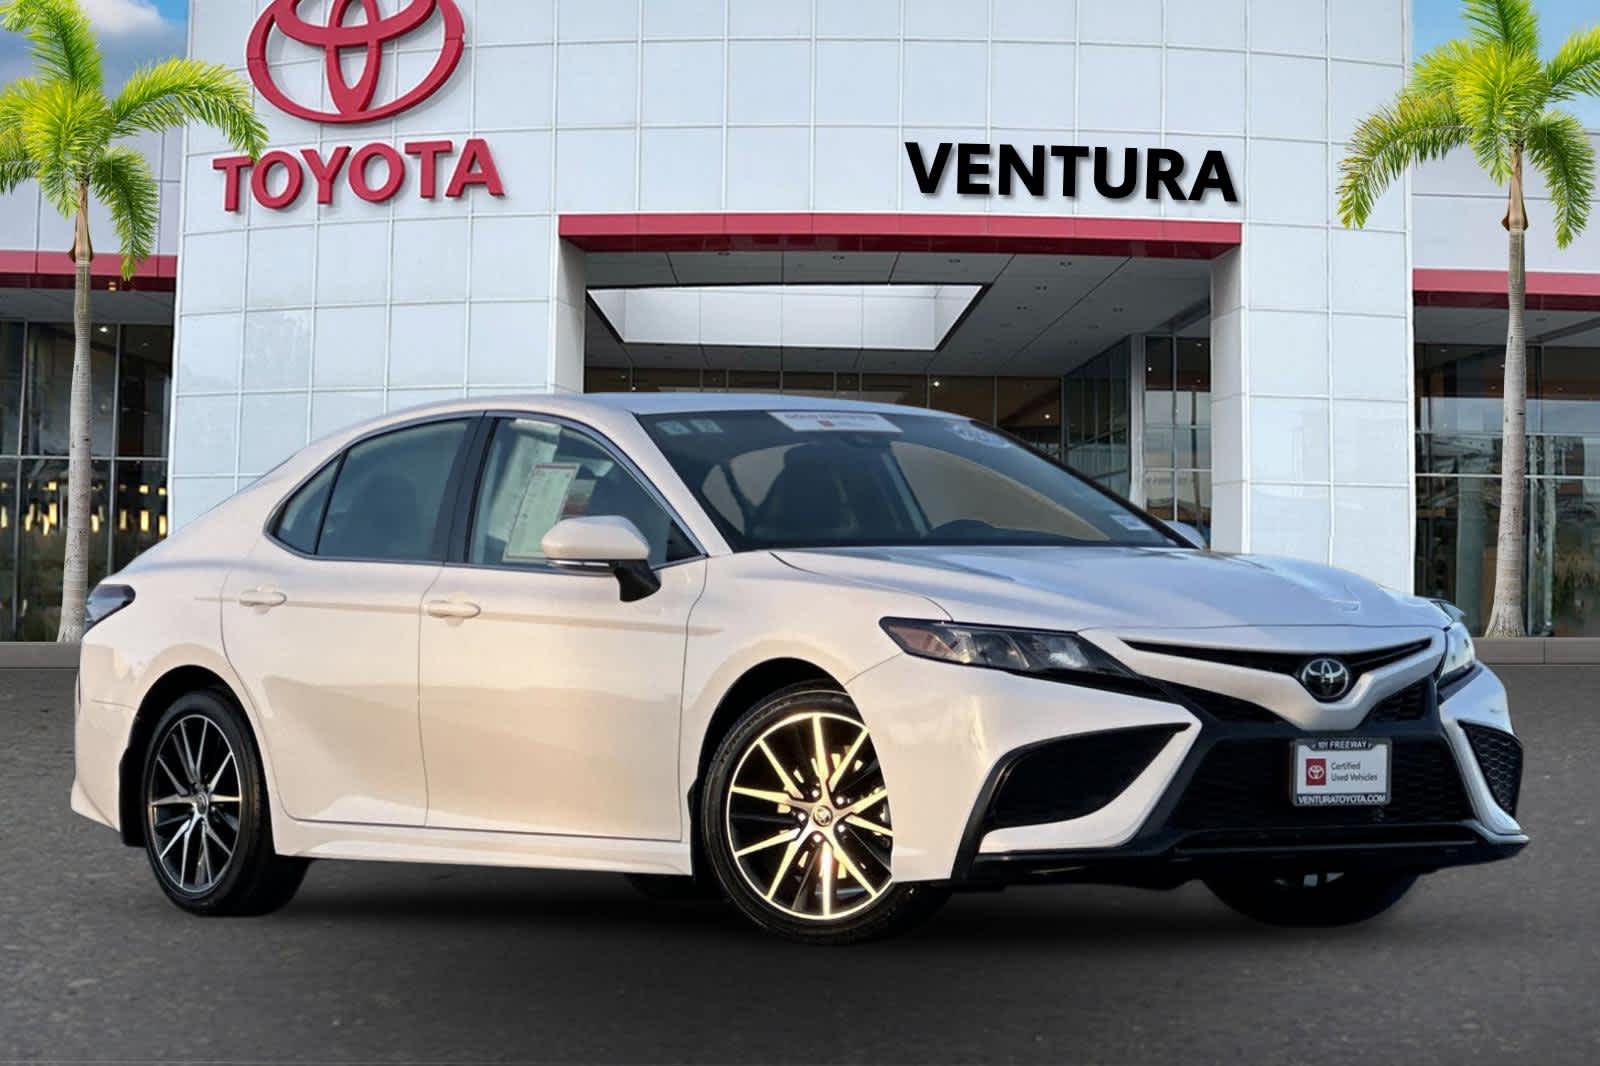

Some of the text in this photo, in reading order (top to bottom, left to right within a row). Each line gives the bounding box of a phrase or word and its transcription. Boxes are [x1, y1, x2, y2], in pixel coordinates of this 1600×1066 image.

[212, 138, 505, 212] TOYOTA
[904, 141, 1239, 203] VENTURA
[1330, 740, 1367, 749] FREEWAY
[1330, 761, 1361, 770] Certified
[1330, 772, 1378, 781] Used Vehicles
[1298, 794, 1386, 805] VENTURATOYOTA.COM
